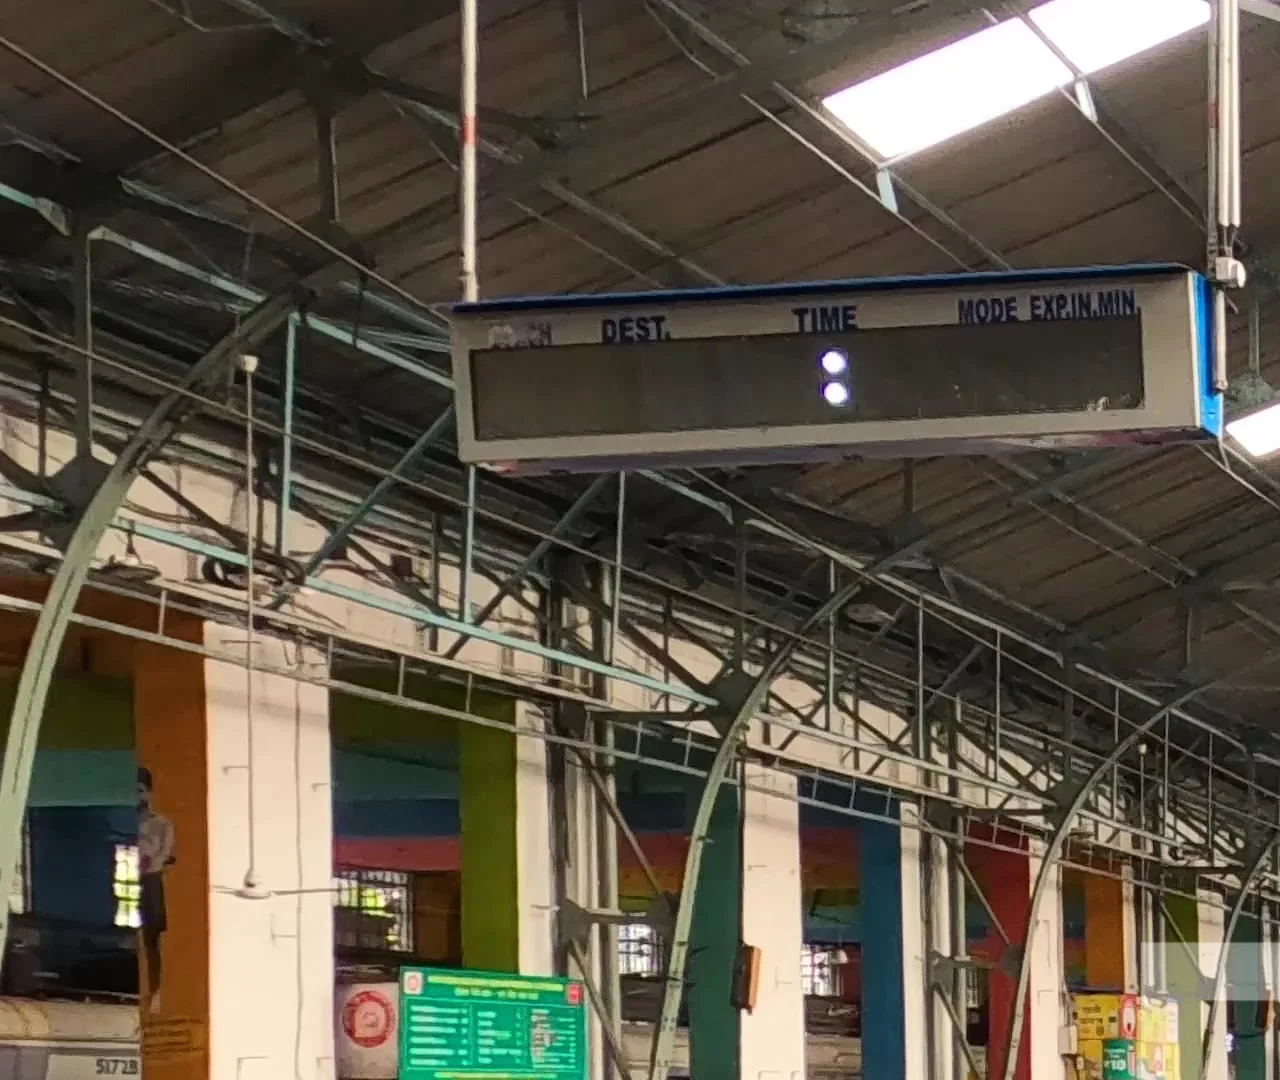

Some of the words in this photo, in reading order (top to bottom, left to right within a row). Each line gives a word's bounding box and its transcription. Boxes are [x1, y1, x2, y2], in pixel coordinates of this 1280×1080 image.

[602, 315, 670, 344] DEST.
[791, 306, 857, 333] TIME
[959, 298, 1018, 324] MODE
